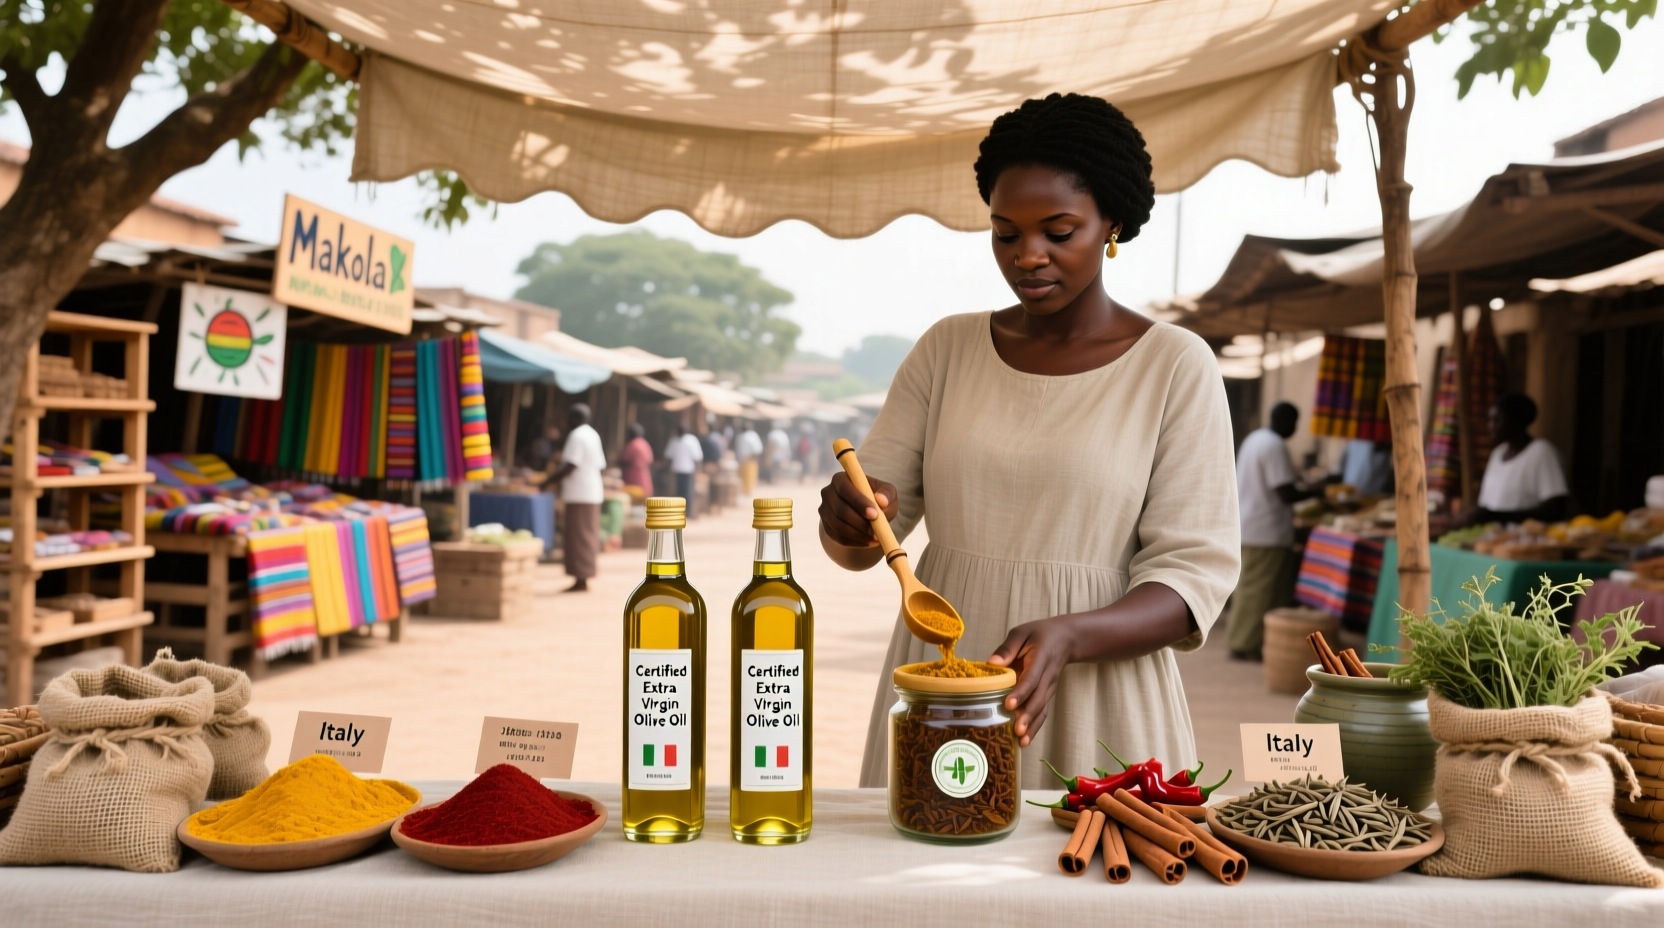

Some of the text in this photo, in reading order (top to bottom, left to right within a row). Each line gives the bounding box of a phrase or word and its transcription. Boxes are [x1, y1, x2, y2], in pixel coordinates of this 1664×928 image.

[289, 209, 386, 290] Makola
[636, 664, 687, 677] Certified
[748, 665, 799, 677] Certified
[643, 681, 677, 694] Extra
[756, 682, 791, 694] Extra
[634, 713, 666, 727] Olive
[746, 714, 779, 728] Olive
[320, 721, 366, 748] Italy
[1267, 733, 1313, 758] Italy
